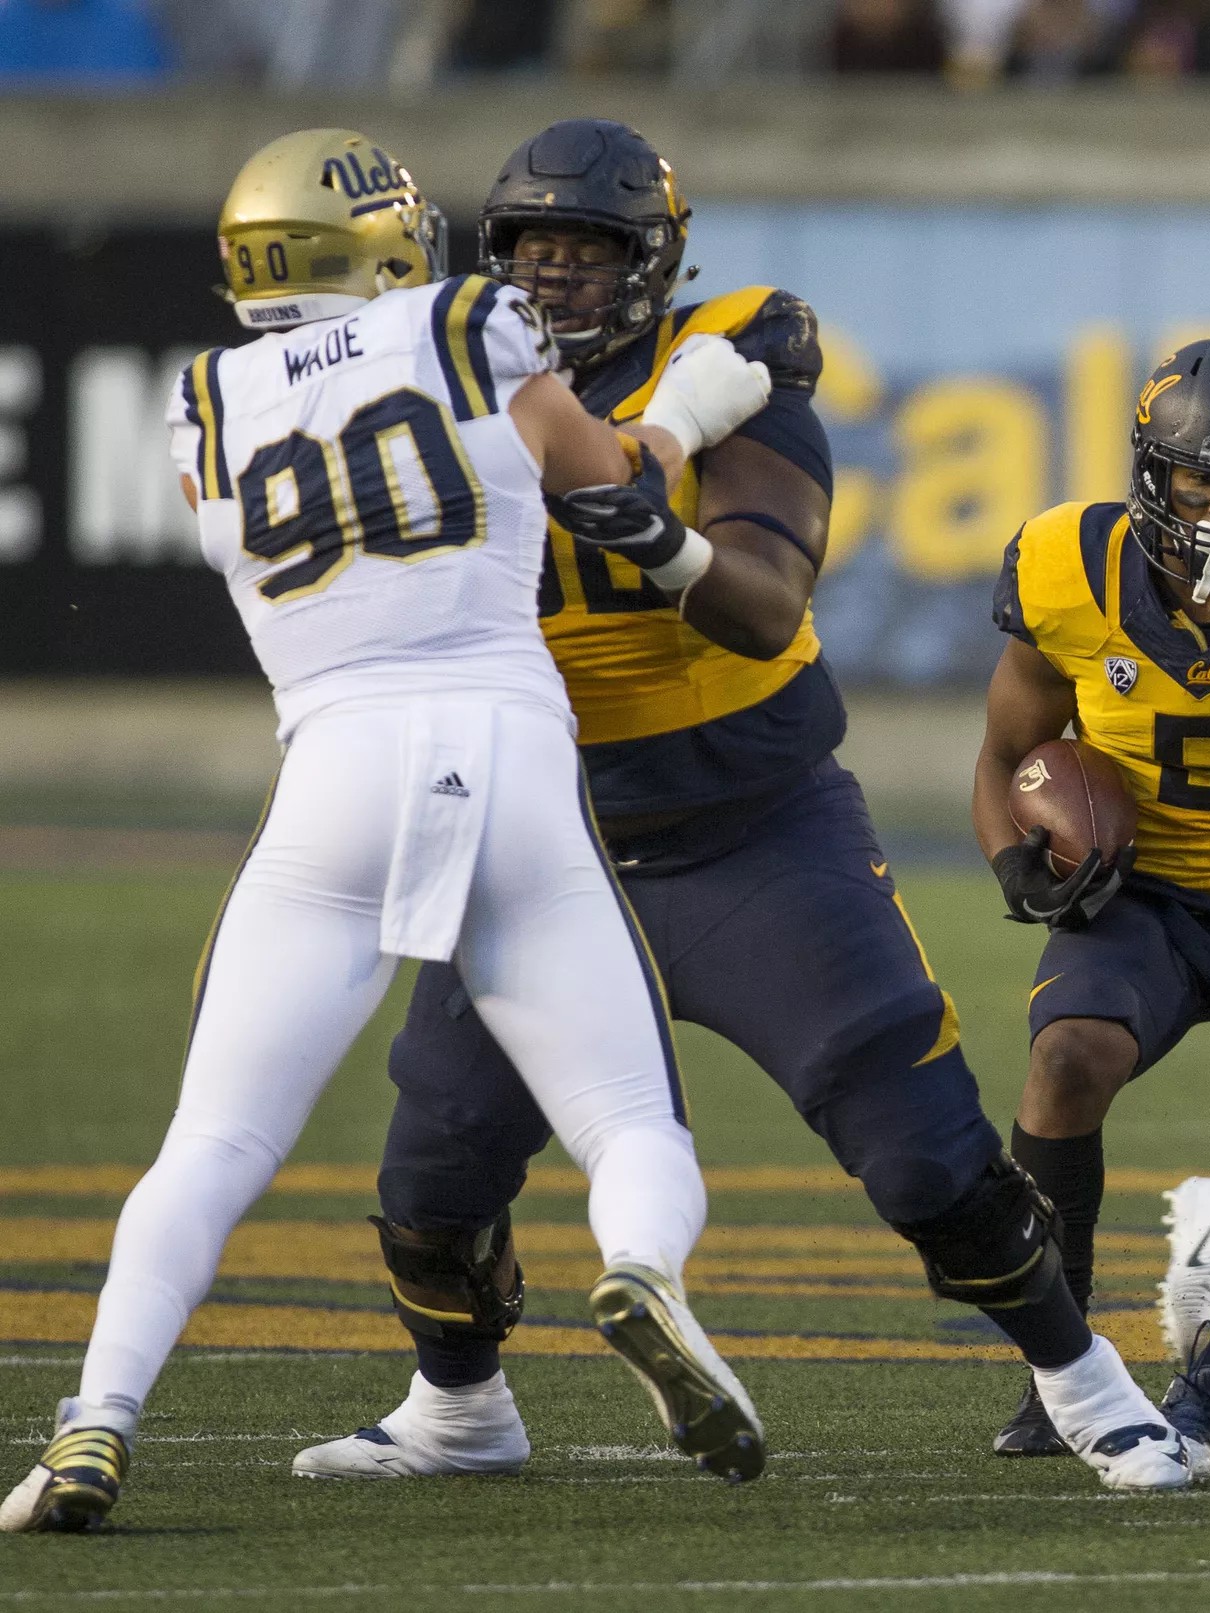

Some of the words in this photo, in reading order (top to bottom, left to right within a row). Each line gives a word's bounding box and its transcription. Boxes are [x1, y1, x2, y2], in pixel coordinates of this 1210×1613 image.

[321, 147, 417, 217] Ucl
[237, 241, 289, 285] 90
[247, 303, 303, 323] BRUINS
[284, 316, 364, 386] WADE
[236, 385, 488, 606] 90
[1113, 672, 1129, 688] 12
